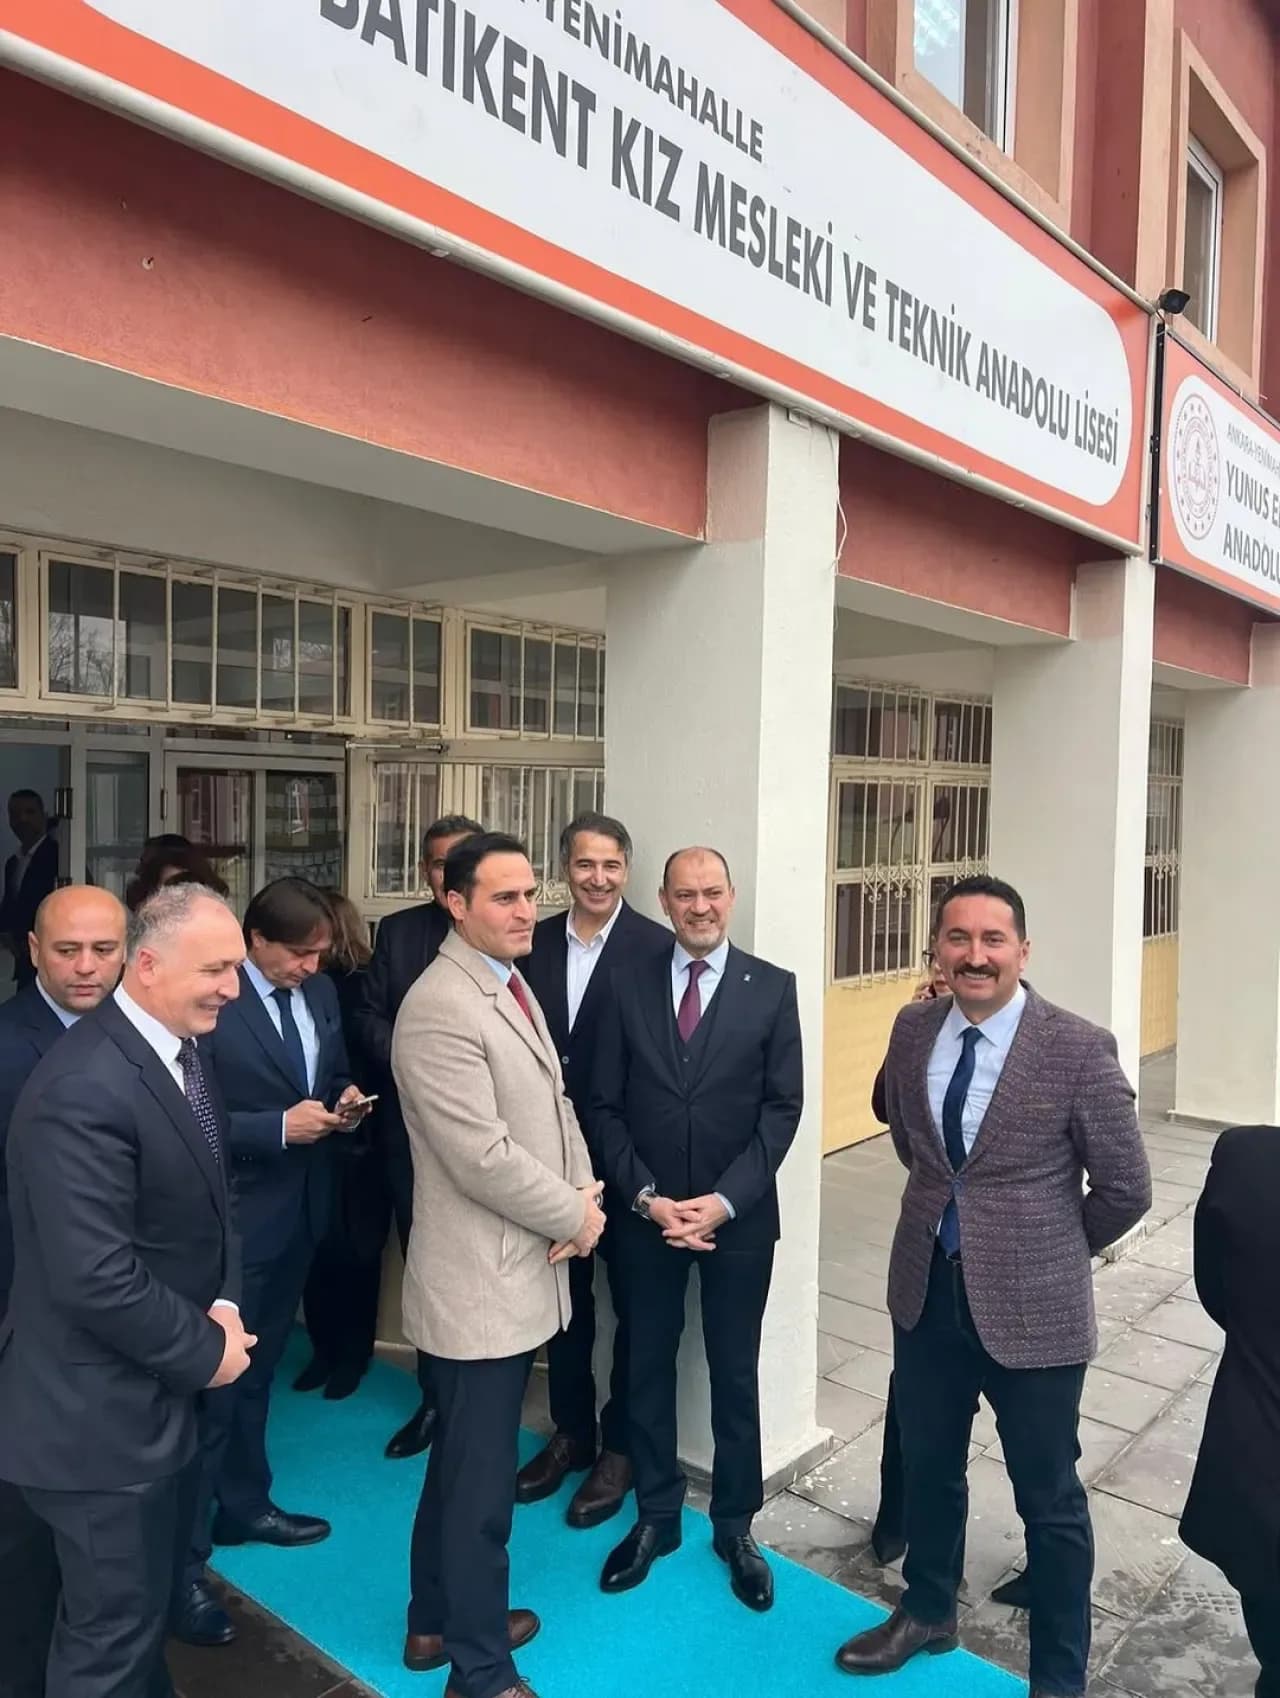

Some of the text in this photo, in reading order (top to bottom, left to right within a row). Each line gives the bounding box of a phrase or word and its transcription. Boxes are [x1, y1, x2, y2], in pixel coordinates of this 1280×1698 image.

[319, 0, 1119, 467] ATIKENT KIZ MESLEKİ VE TEKNİK ANADOLU LİSESİ
[1226, 460, 1269, 520] YUNUS
